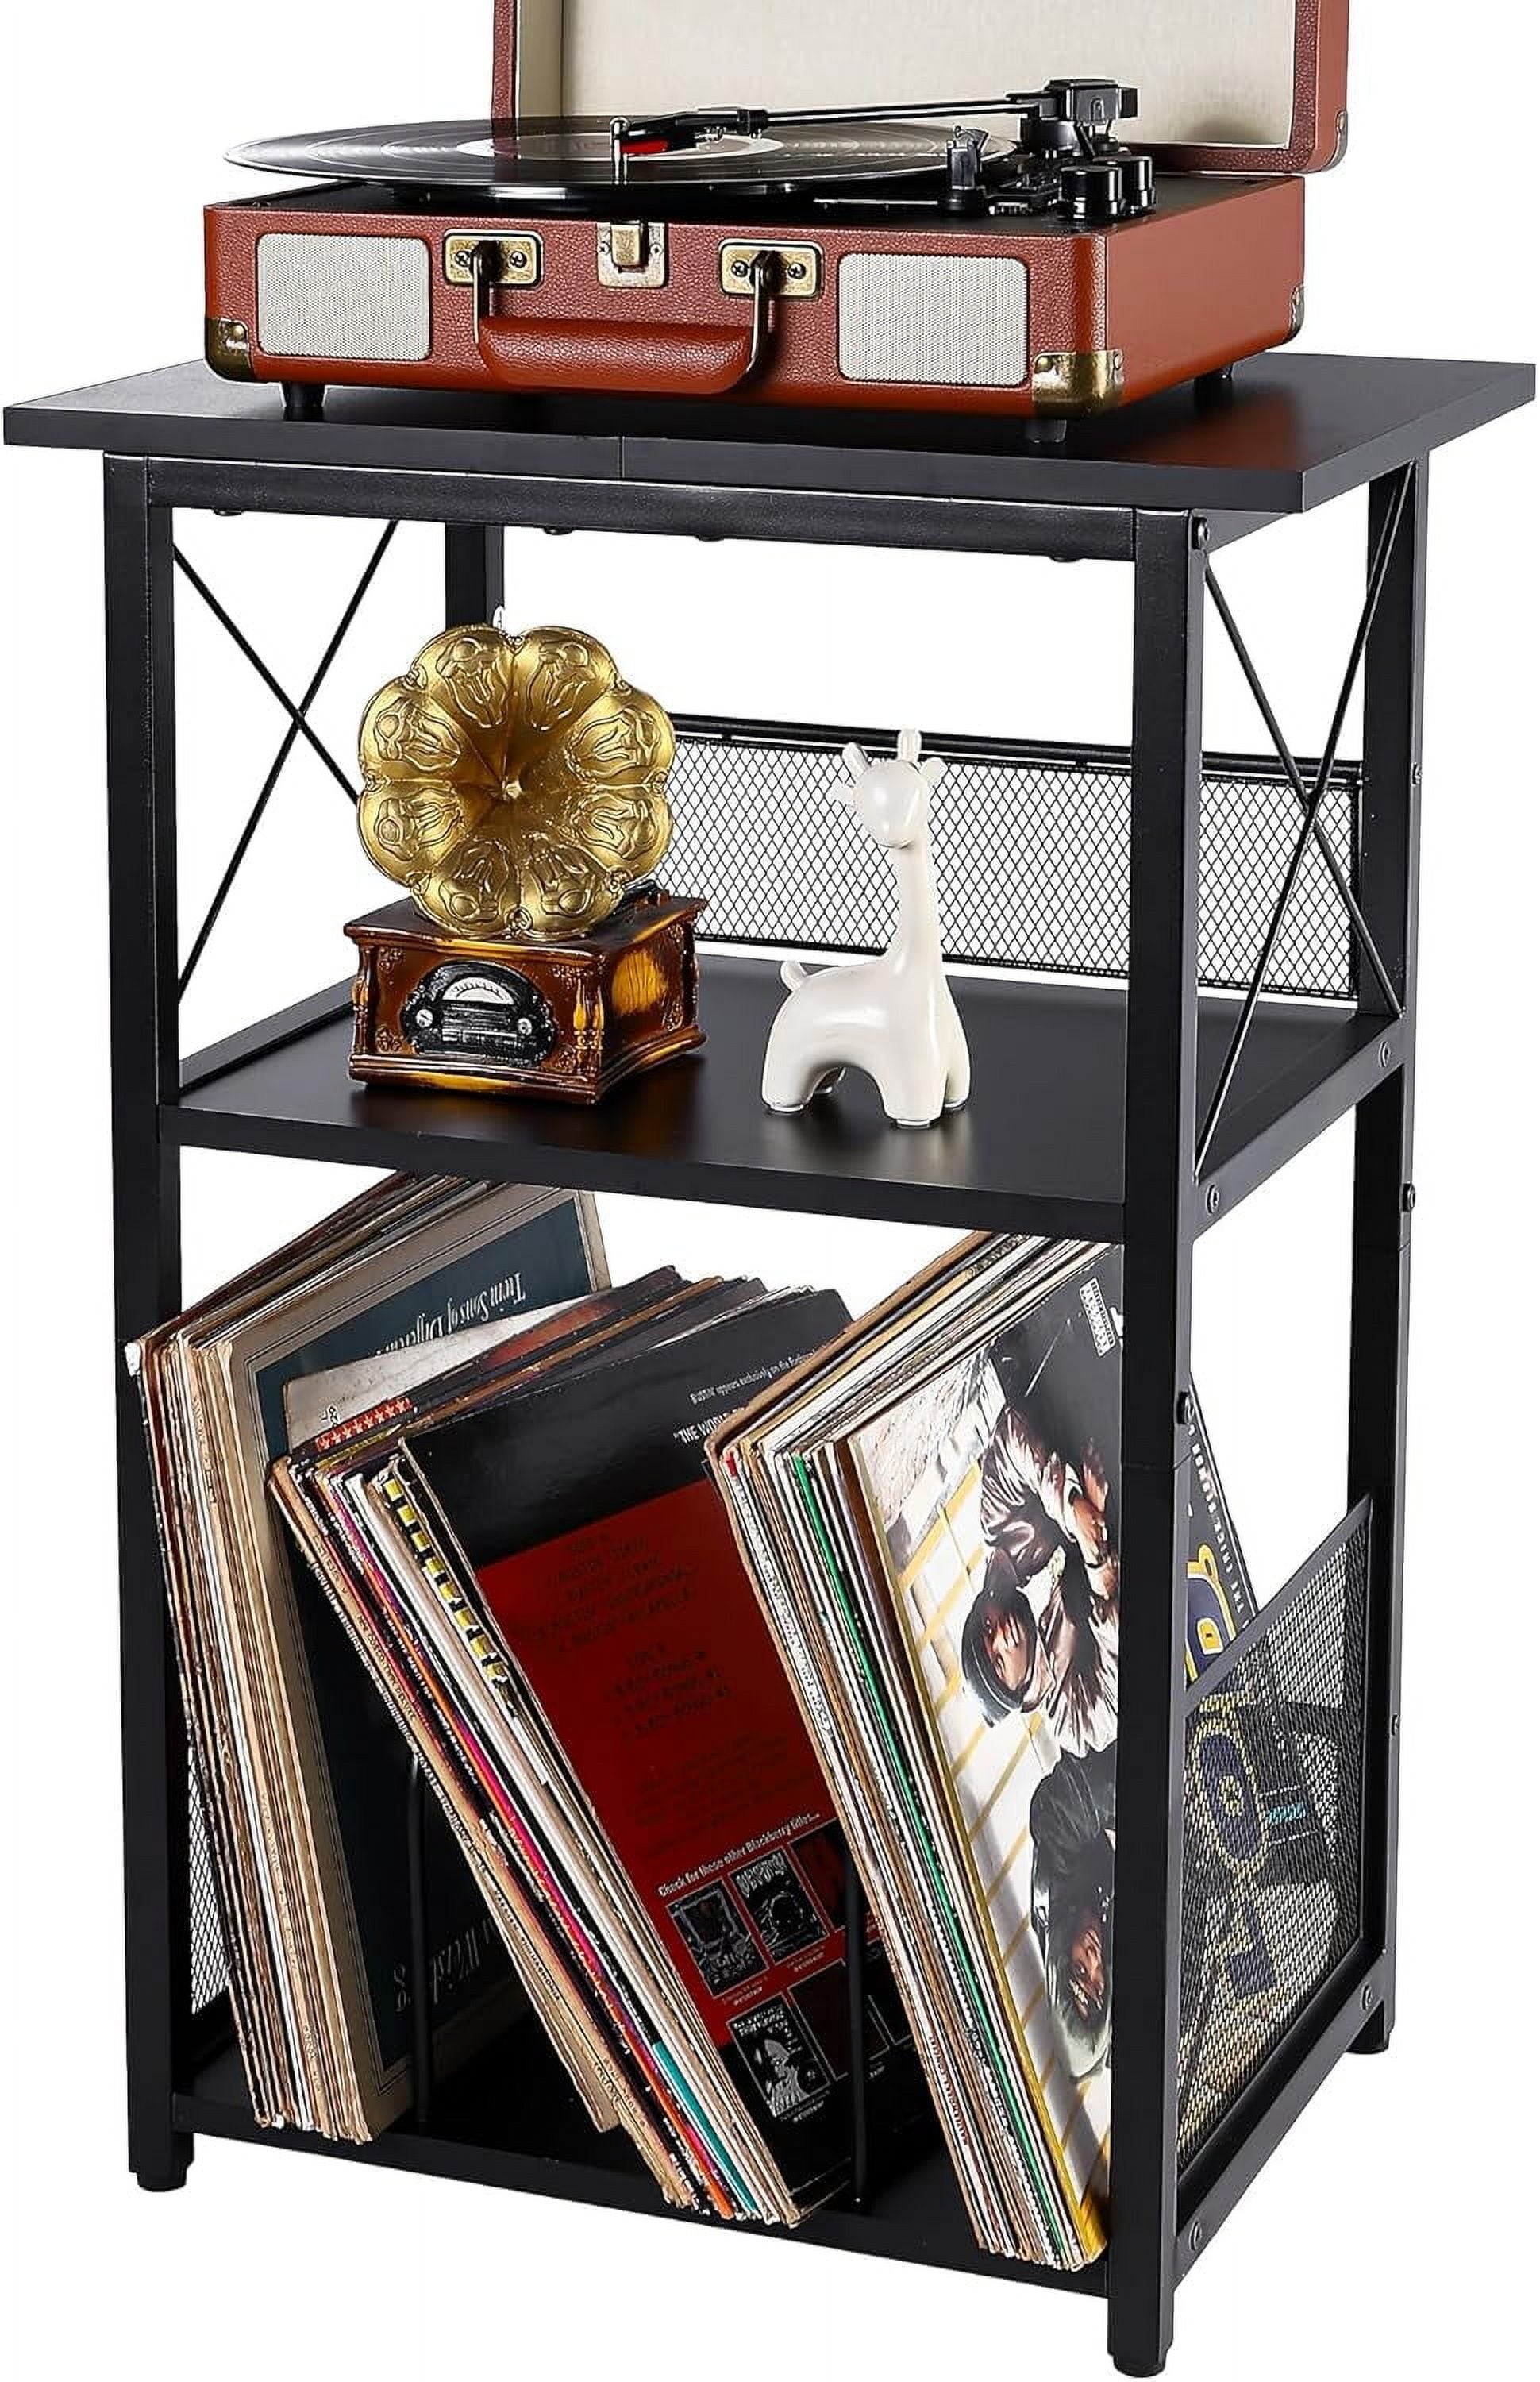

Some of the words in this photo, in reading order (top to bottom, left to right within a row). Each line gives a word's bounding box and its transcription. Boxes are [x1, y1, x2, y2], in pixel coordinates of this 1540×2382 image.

[460, 1290, 489, 1324] Sons
[491, 1272, 526, 1312] Twin
[447, 1297, 459, 1334] of
[684, 1870, 700, 1884] for
